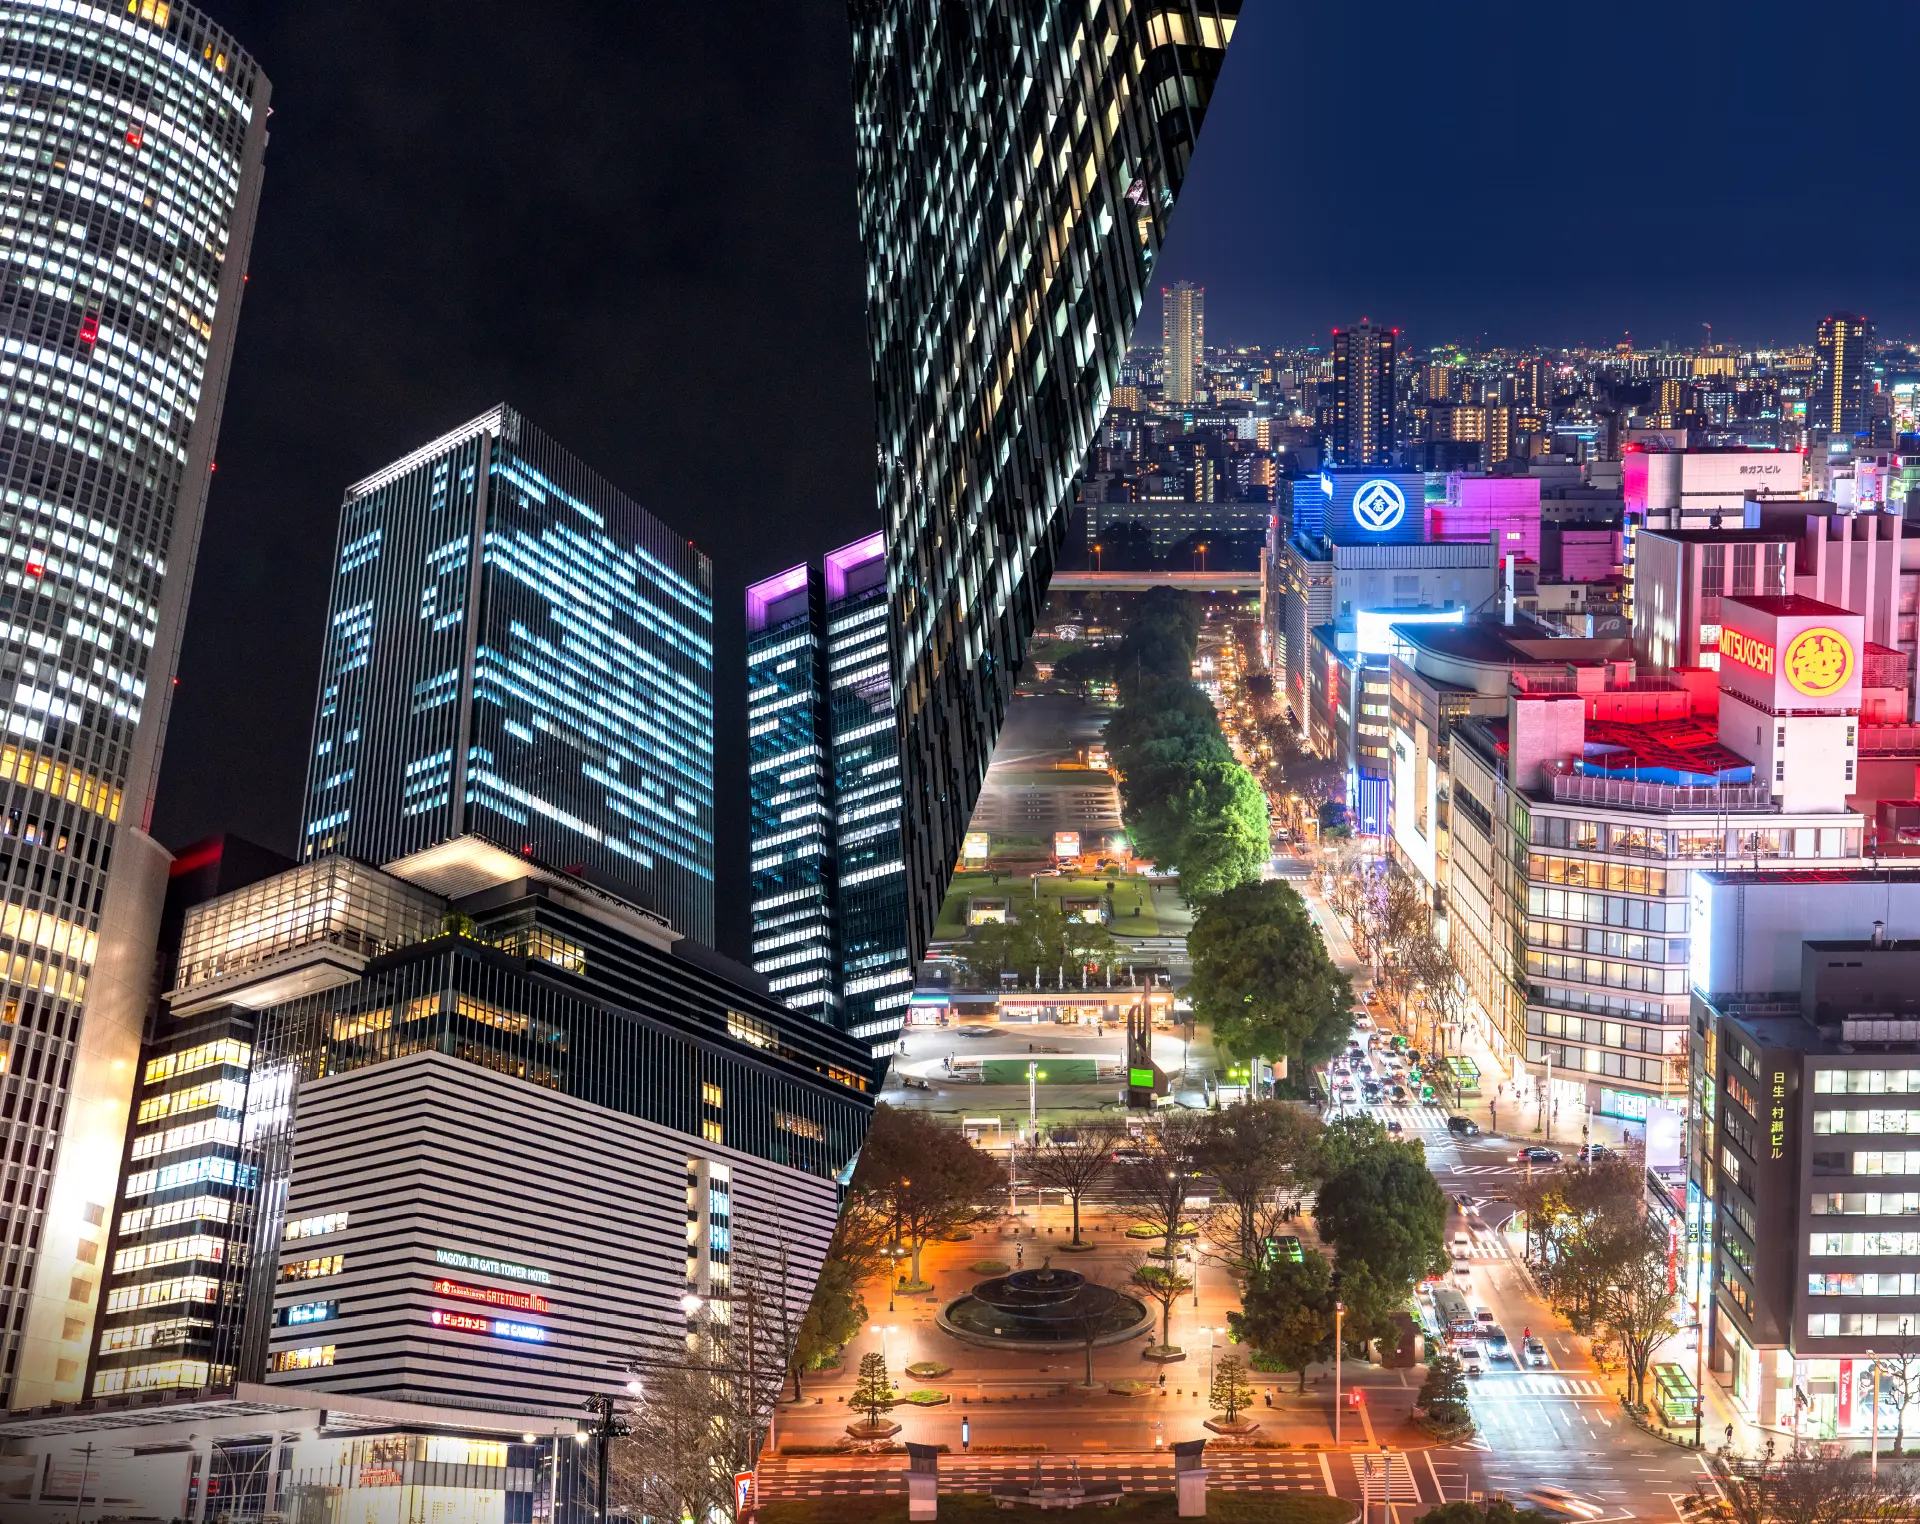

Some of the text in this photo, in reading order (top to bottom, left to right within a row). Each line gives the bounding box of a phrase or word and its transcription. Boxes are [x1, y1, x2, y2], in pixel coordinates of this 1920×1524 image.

[1719, 627, 1774, 675] MITSUKOSHI
[436, 1250, 551, 1284] NAGOYA JR GATE TOWER HOTEL
[442, 1313, 488, 1331] ビックカメラ
